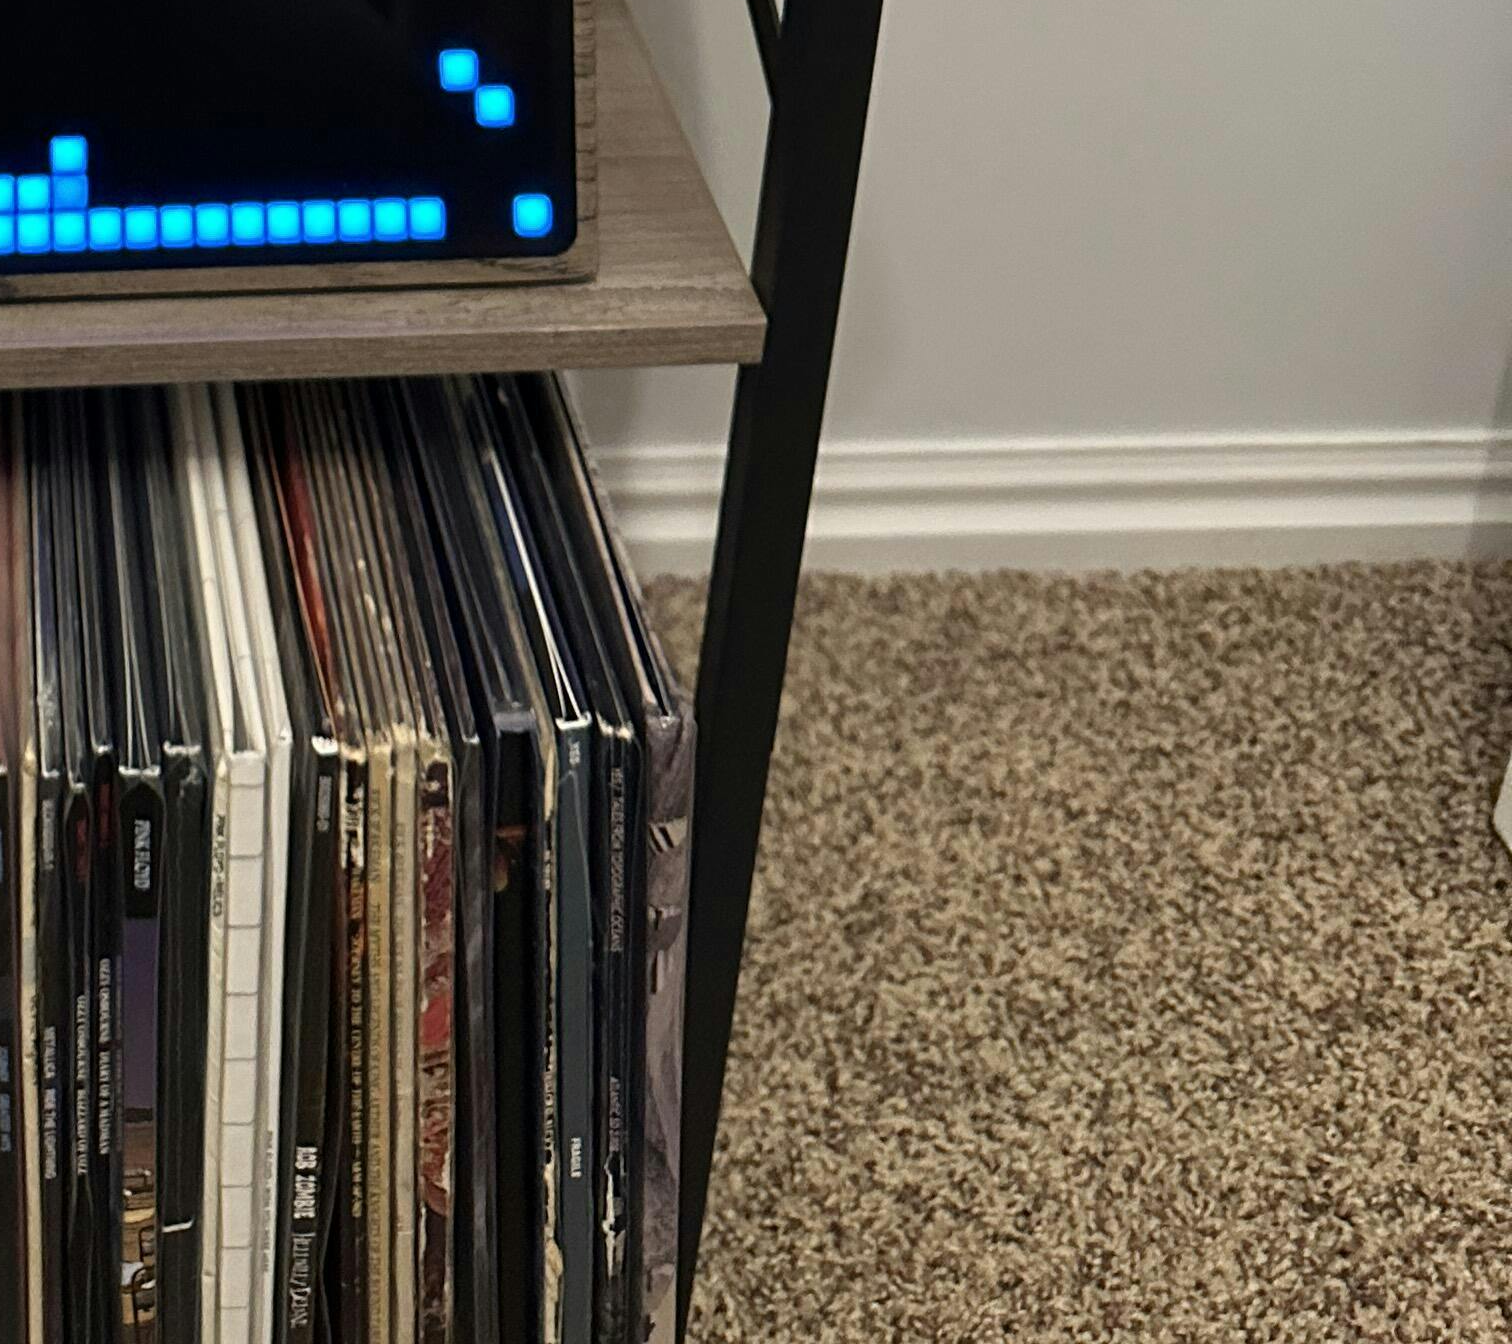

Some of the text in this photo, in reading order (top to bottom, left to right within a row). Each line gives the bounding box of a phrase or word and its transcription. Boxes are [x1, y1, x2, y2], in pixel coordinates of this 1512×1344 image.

[295, 1146, 318, 1169] ROB
[569, 1137, 583, 1179] FRAGILE
[293, 1174, 317, 1219] ZOMBIE
